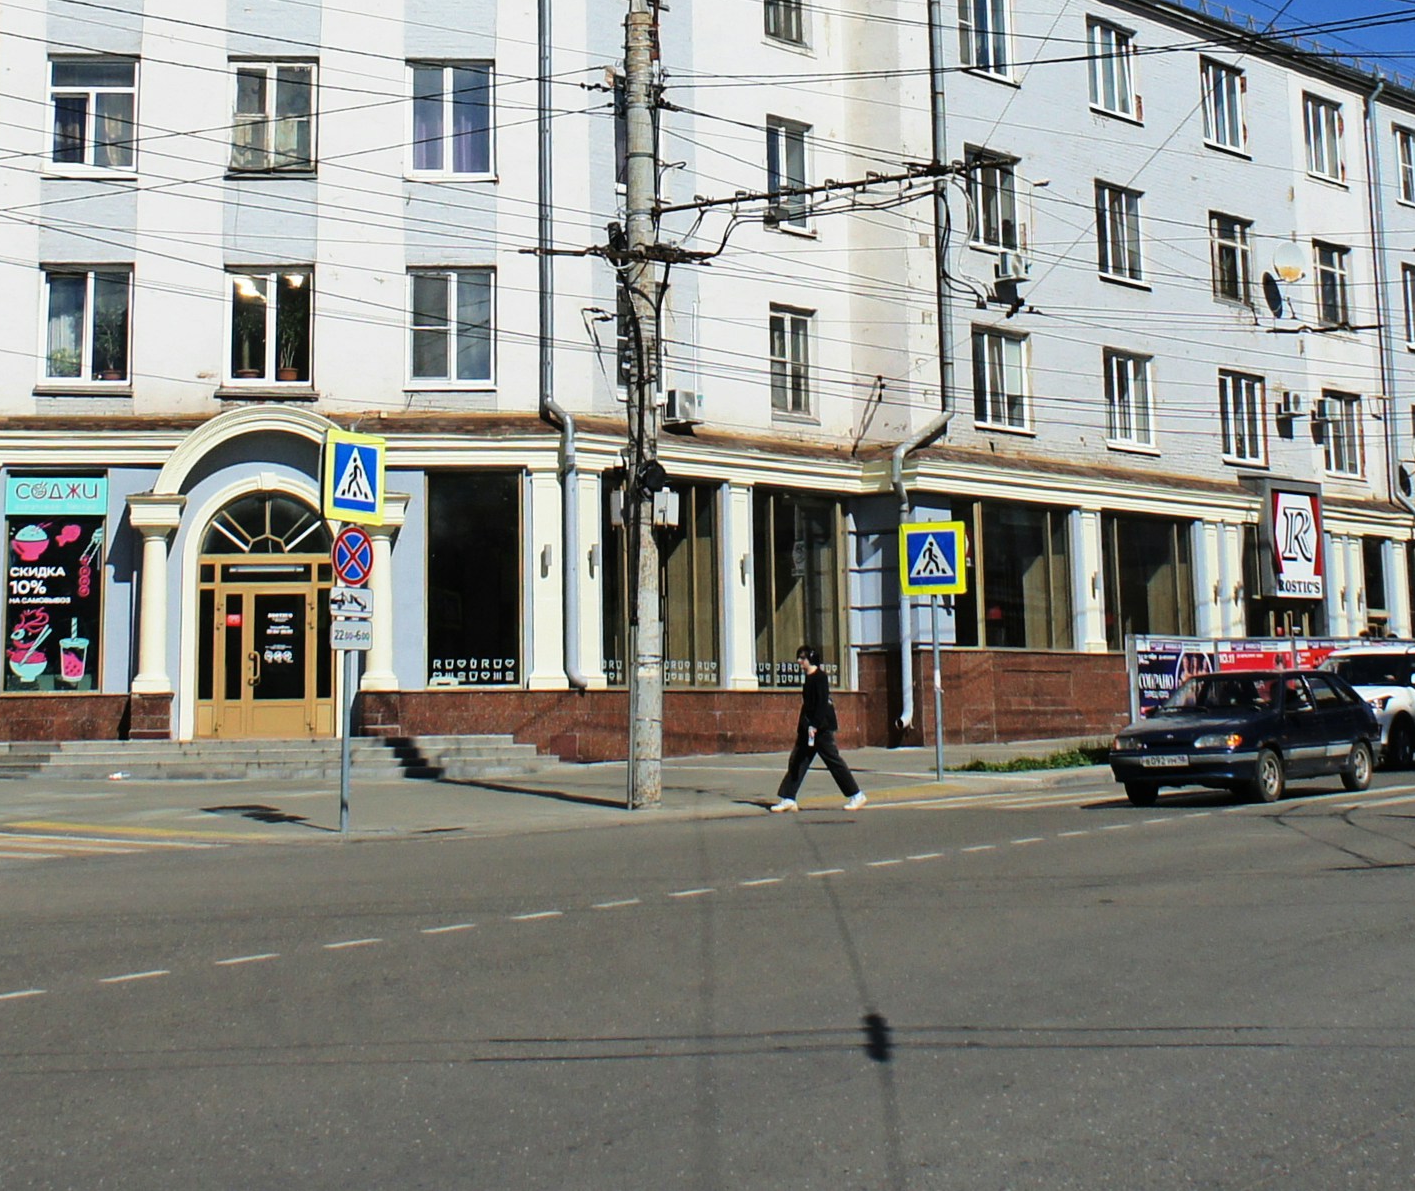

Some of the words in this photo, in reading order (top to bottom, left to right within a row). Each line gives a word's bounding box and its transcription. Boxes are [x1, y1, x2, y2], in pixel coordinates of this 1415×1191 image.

[16, 481, 98, 500] СОДЖИ
[1282, 506, 1313, 563] R
[9, 566, 66, 579] СКИДКА
[9, 579, 47, 595] 10%
[1277, 578, 1321, 594] ROSTIC'S
